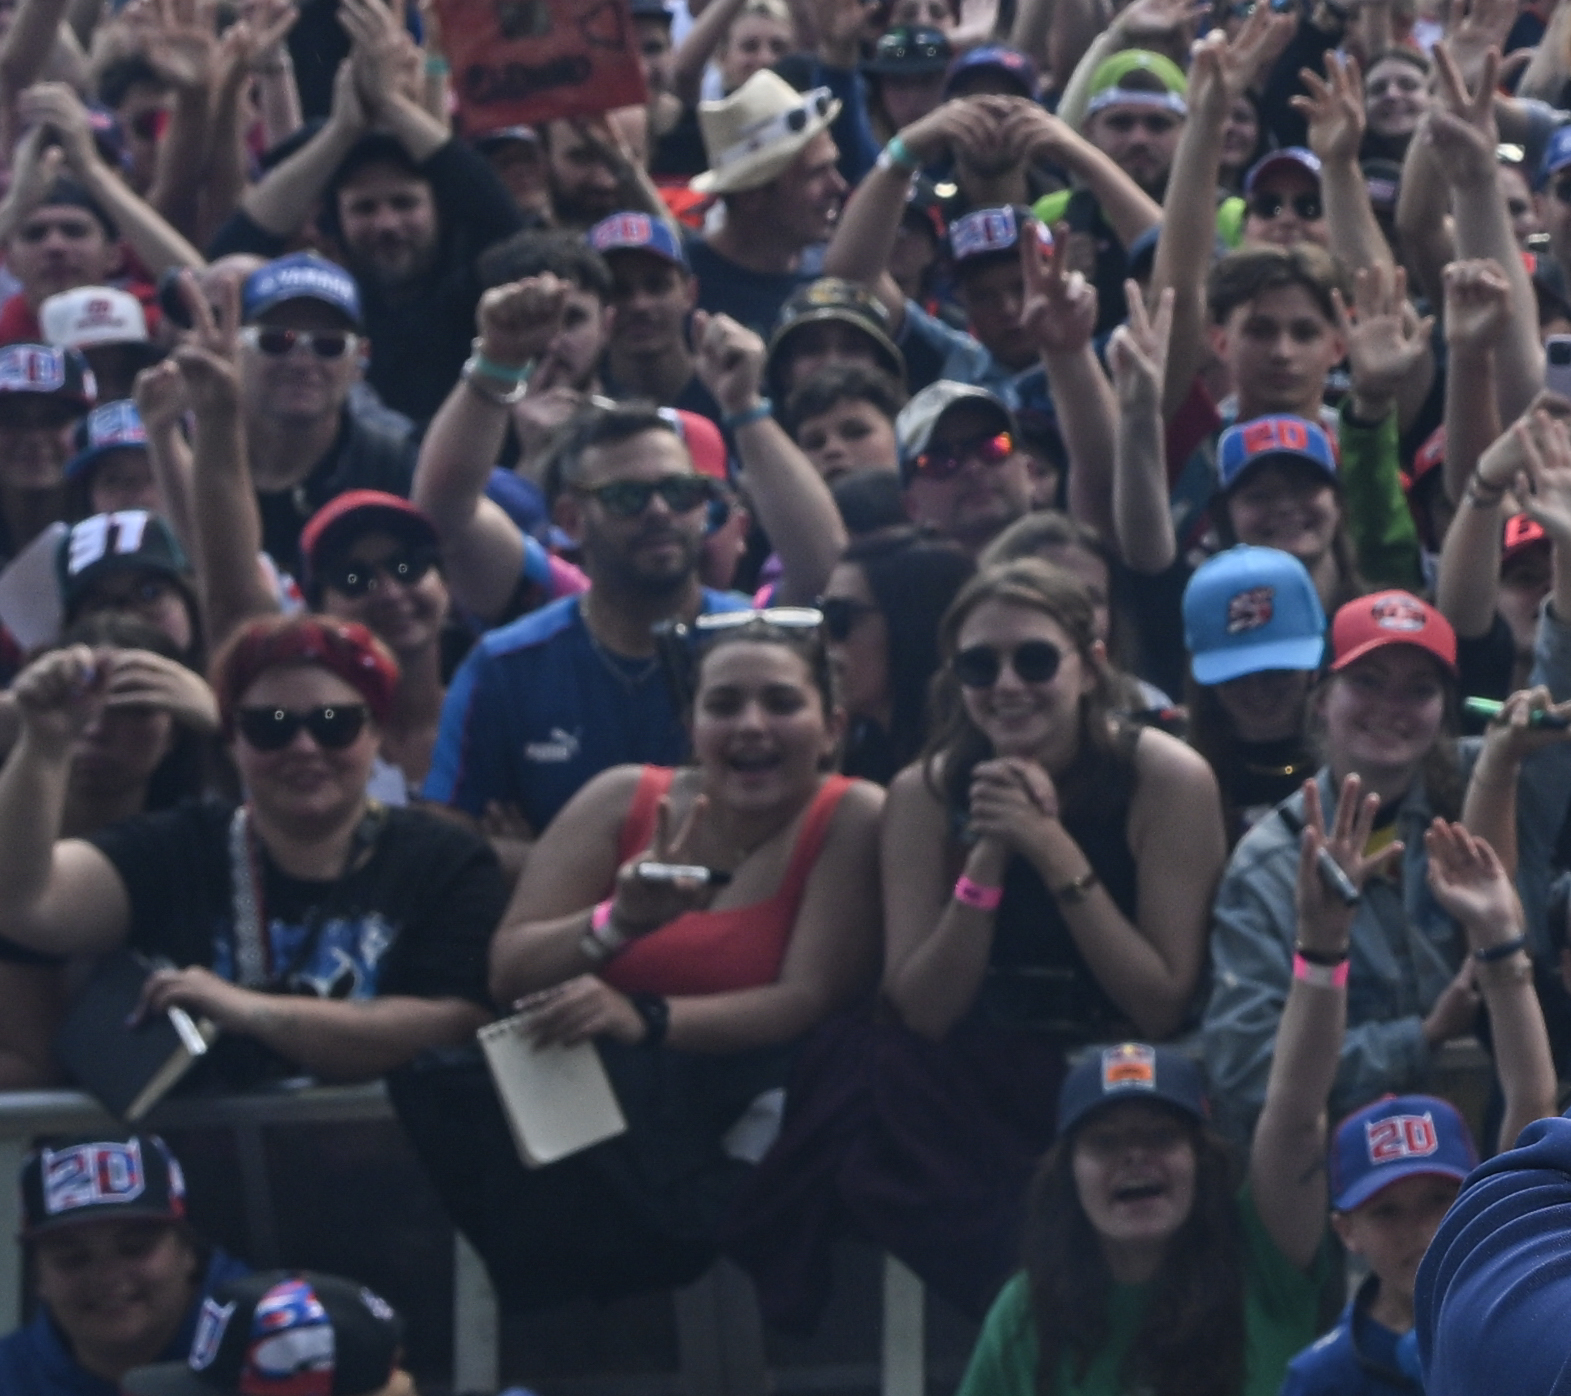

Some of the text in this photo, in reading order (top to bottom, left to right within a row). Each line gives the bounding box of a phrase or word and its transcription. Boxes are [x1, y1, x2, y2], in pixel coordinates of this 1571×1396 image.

[1243, 421, 1310, 456] 20
[1365, 1110, 1438, 1167] 20
[42, 1137, 146, 1216] 20
